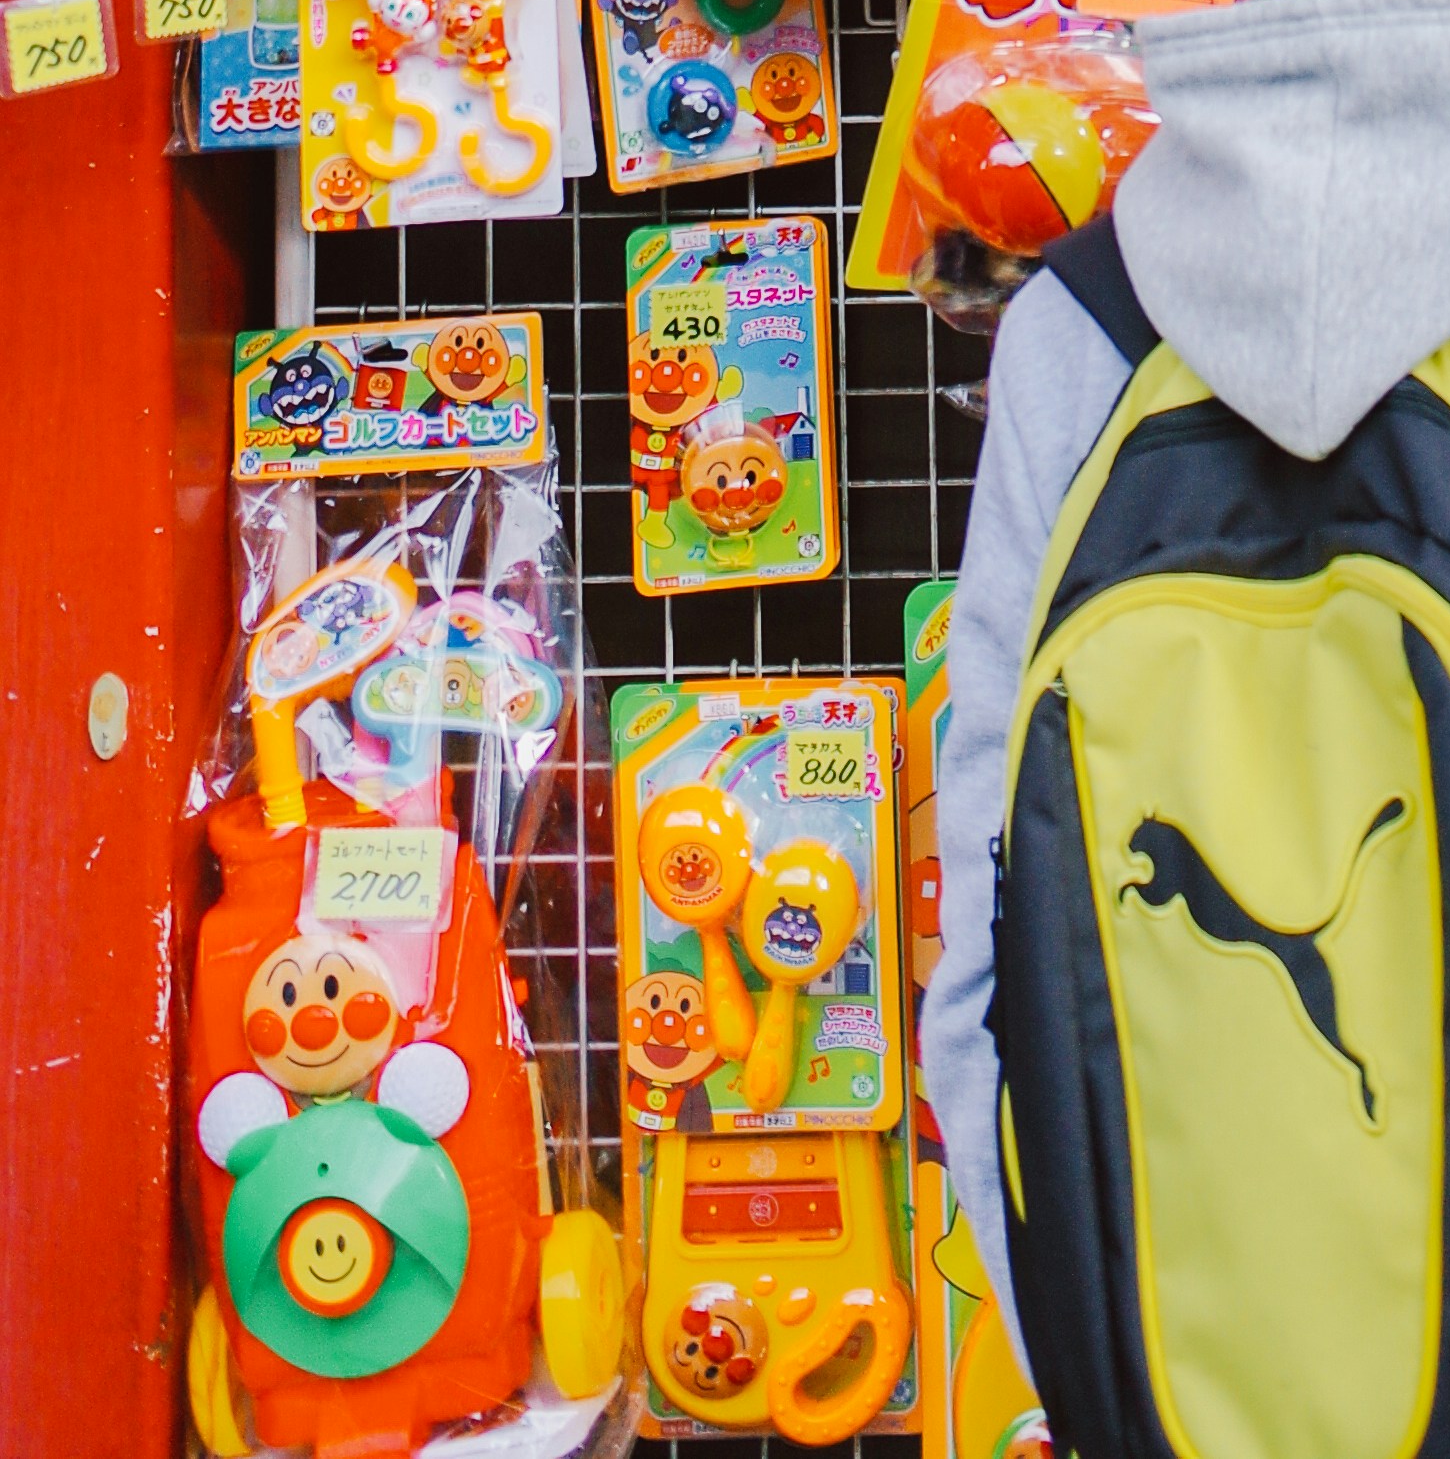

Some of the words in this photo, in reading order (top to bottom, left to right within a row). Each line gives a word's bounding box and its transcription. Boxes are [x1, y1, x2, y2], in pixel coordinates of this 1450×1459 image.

[26, 35, 87, 78] 750
[727, 284, 814, 308] スタネット
[244, 427, 323, 448] アンパンマン
[325, 406, 537, 449] ゴルフカートセット
[795, 743, 844, 755] マラカス
[670, 887, 724, 907] ANPANMAN
[826, 1006, 875, 1021] マラカスを
[803, 1114, 874, 1127] PINOCCHIO
